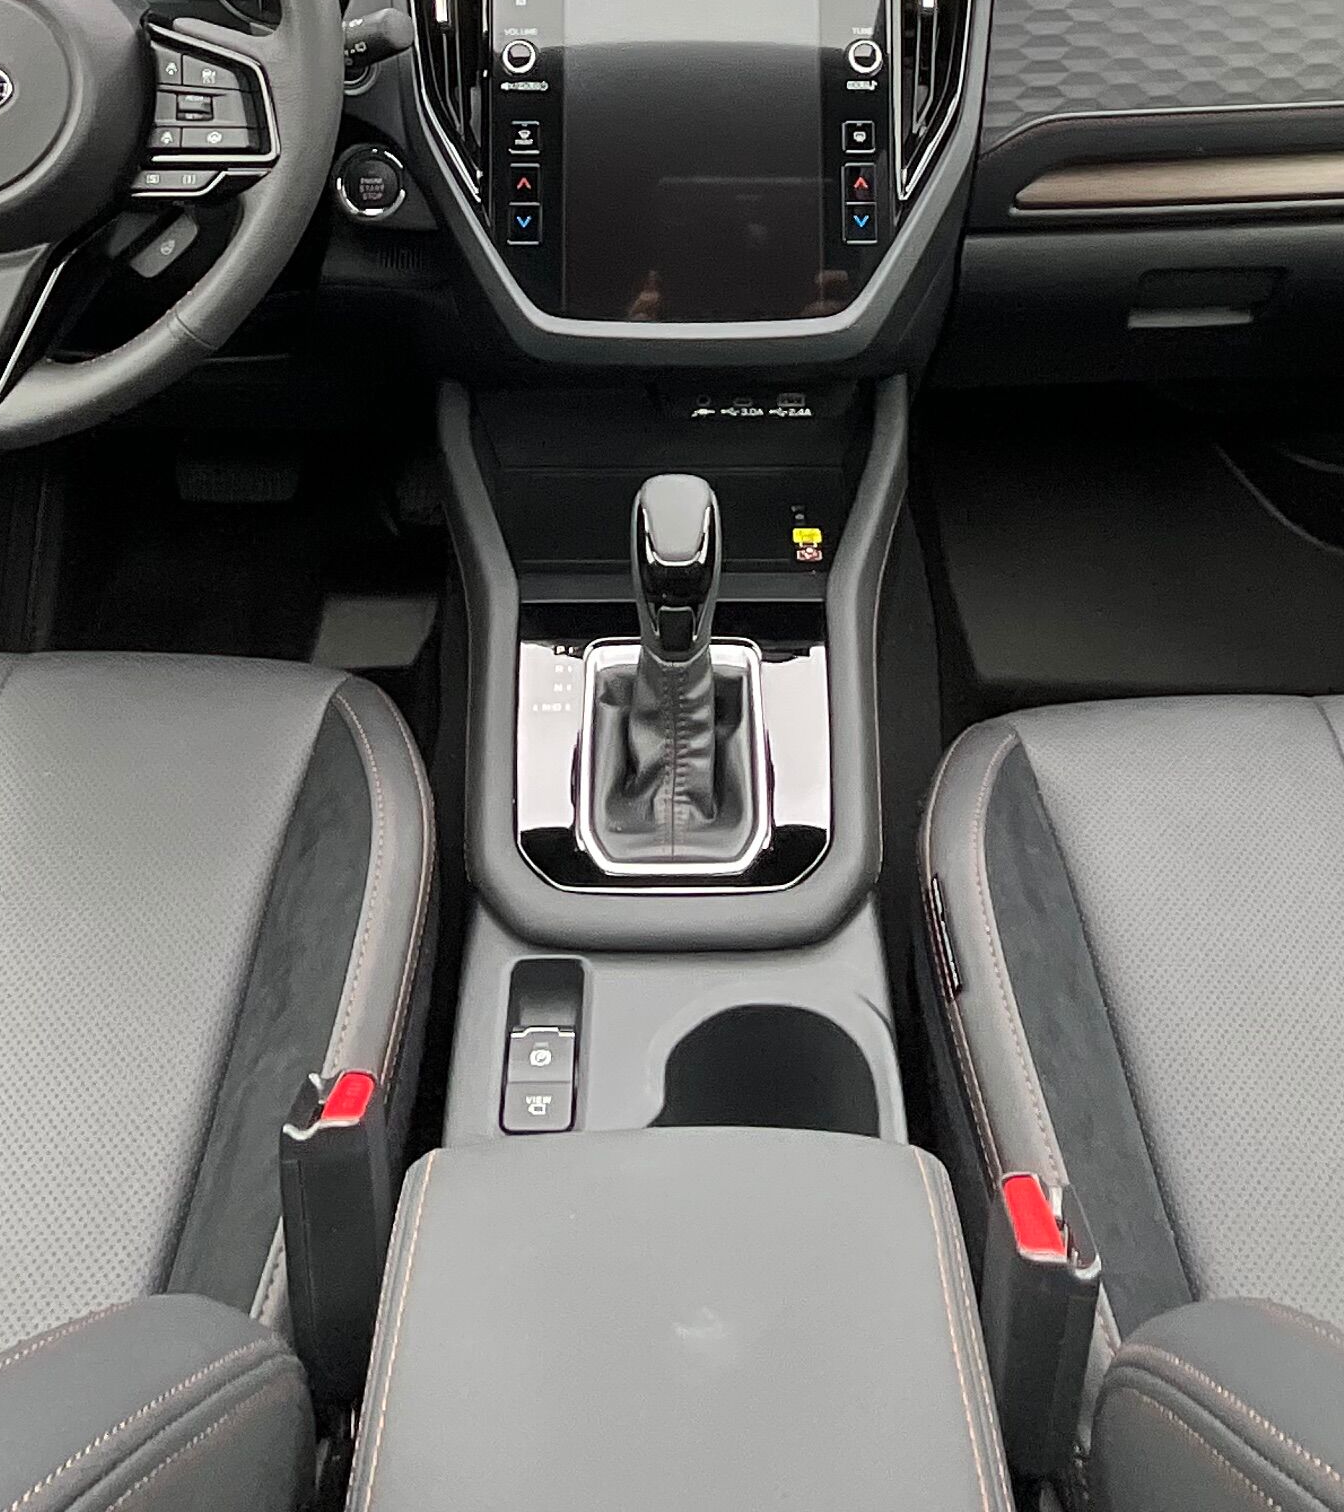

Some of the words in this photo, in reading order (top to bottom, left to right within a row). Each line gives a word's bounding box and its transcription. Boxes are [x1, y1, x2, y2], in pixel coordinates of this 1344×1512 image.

[504, 28, 538, 36] VOLUME
[852, 27, 873, 35] TUNE
[525, 1095, 552, 1104] VIEW
